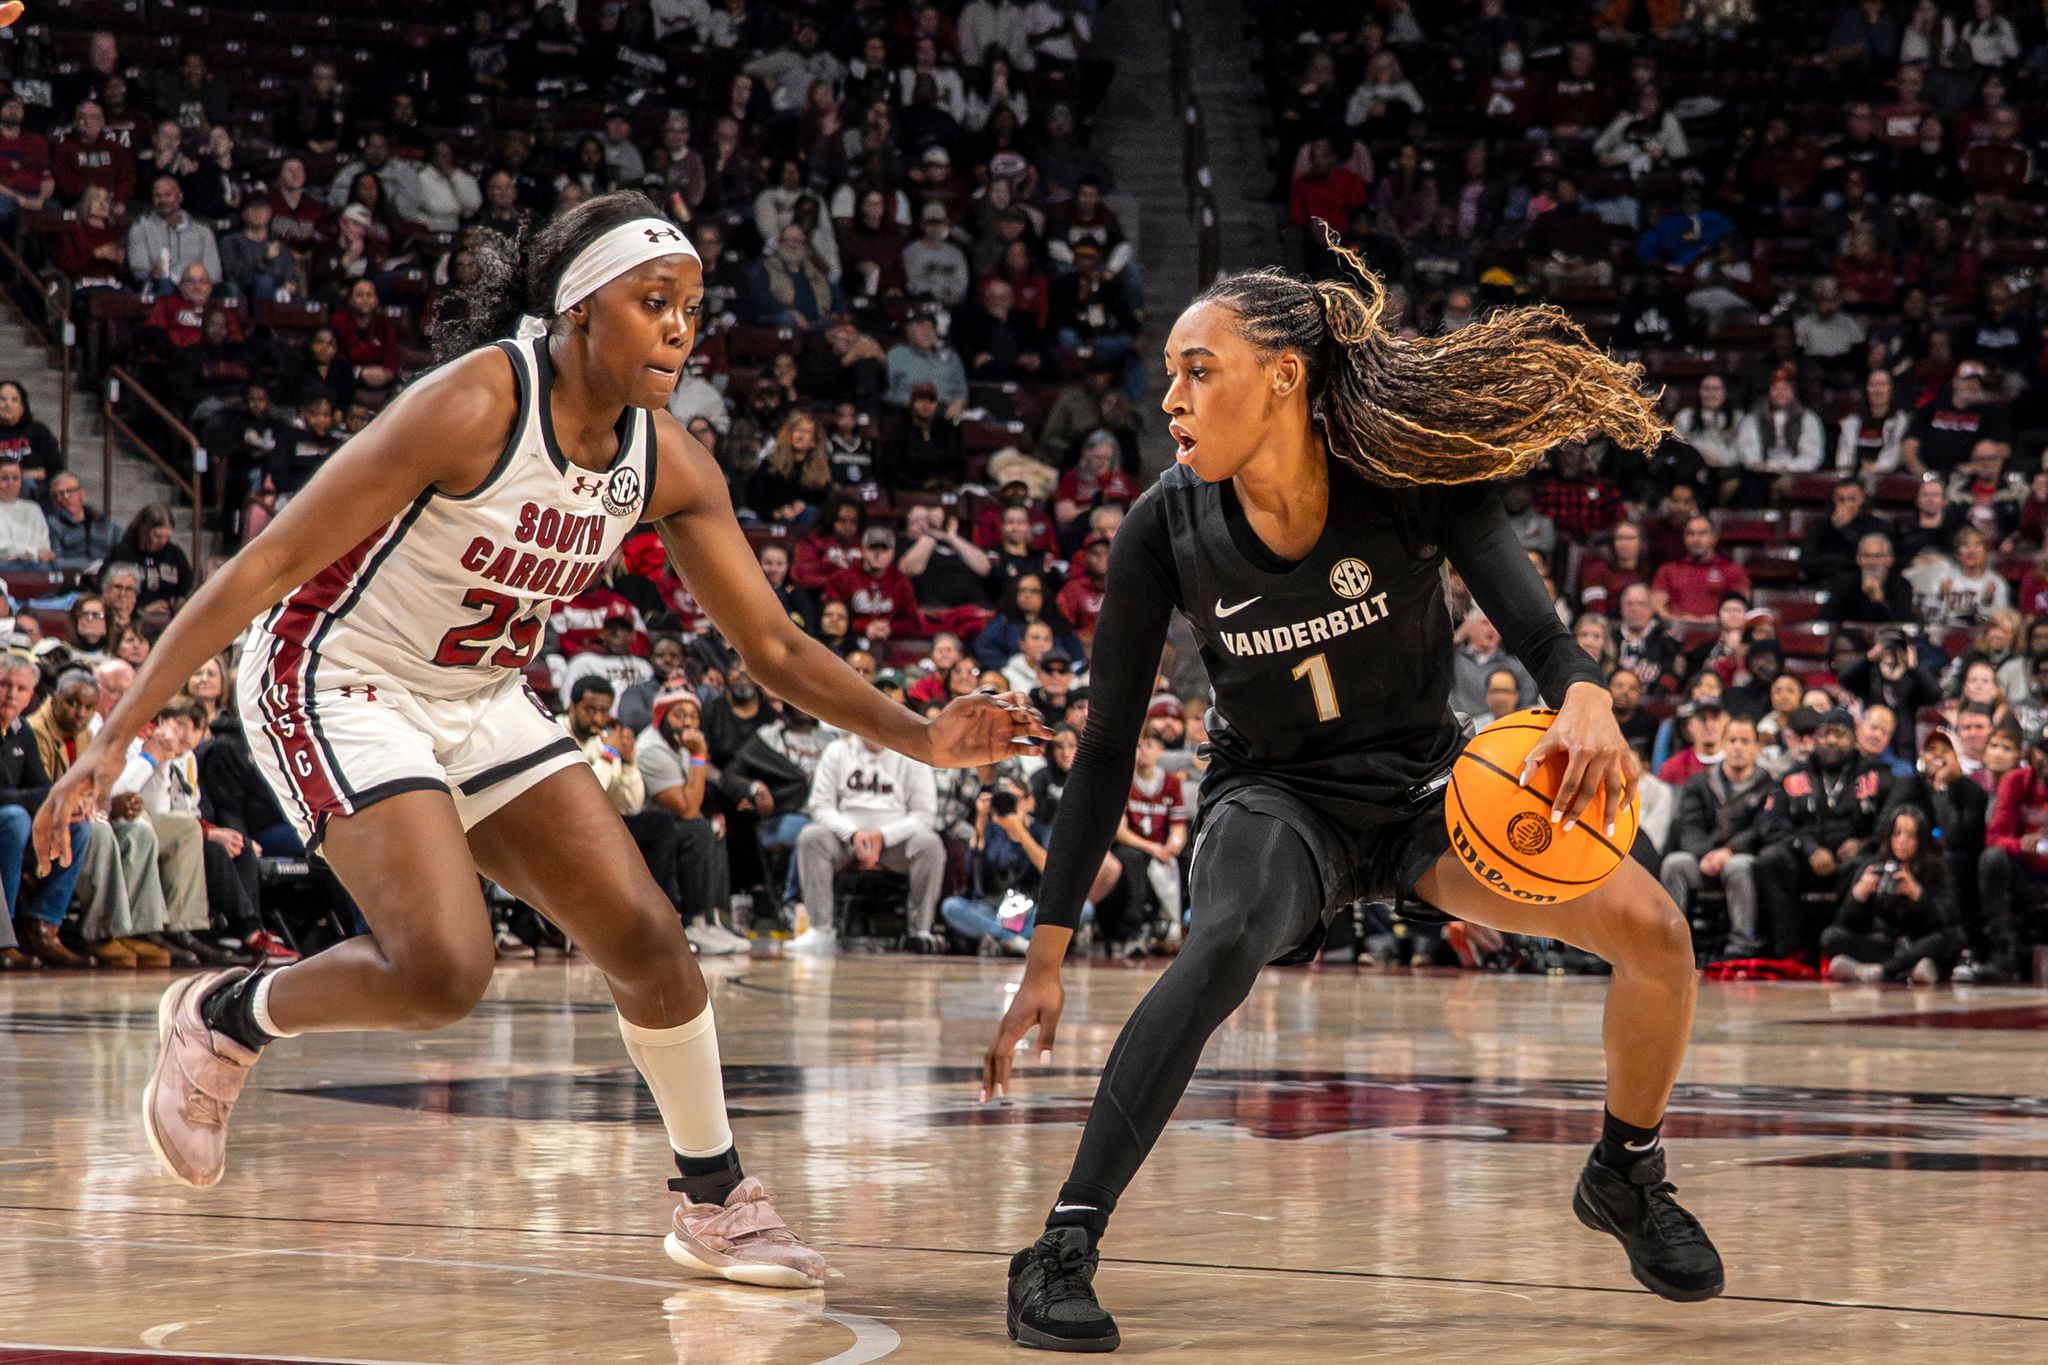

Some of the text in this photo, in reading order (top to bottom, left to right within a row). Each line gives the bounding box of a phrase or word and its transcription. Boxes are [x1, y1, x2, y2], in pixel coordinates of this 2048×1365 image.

[611, 468, 639, 504] SEC
[515, 501, 606, 556] SOUTH
[1332, 560, 1369, 597] SEC
[1220, 591, 1390, 656] VANDERBILT
[1291, 652, 1342, 723] 1
[1453, 820, 1557, 903] Wilson
